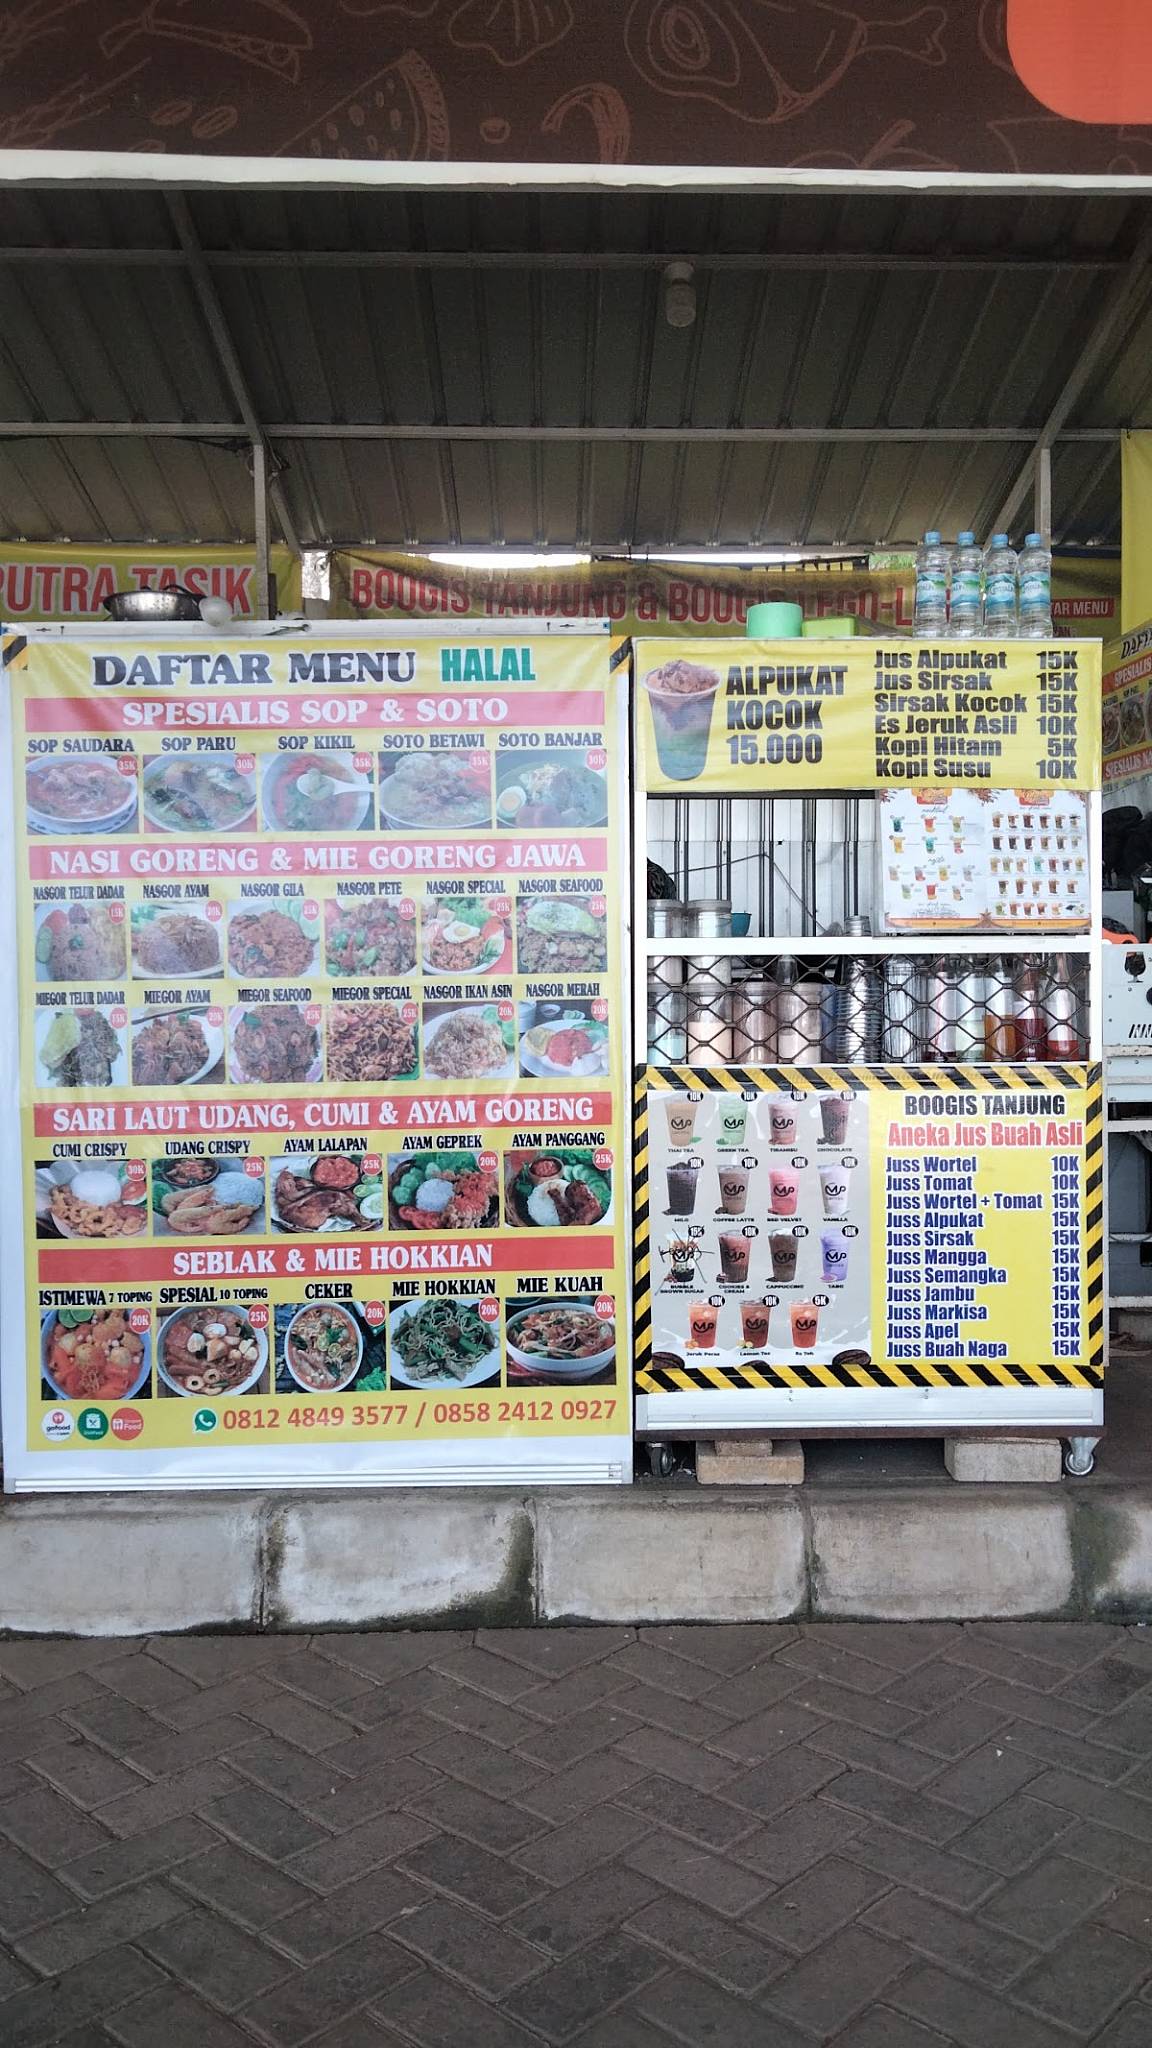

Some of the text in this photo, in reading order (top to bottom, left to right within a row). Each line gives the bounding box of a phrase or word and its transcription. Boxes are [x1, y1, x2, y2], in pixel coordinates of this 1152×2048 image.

[0, 566, 117, 613] UTRA
[353, 568, 657, 620] BOOGIS TANJUNG &
[1073, 601, 1108, 615] MENU
[93, 648, 536, 686] DAFTAR MENU HALAL
[874, 650, 1078, 669] Jus Alpukat 15K
[726, 666, 848, 695] ALPUKAT
[874, 671, 1078, 691] Jus Sirsak 15K
[874, 693, 1078, 713] Sirsak Kocok 15K
[123, 698, 508, 725] SPESIALIS SOP & SOTO
[726, 700, 823, 730] KOCOK
[875, 715, 1078, 735] Es Jeruk Asli 10K
[28, 738, 134, 753] SOP SAUDARA
[161, 737, 236, 751] SOP PARU
[278, 735, 355, 749] SOP KIKIL
[383, 734, 485, 749] SOTO BETAWI
[499, 732, 603, 747] SOTO BANJAR
[875, 737, 1077, 757] Kopi Hitam 5K
[726, 734, 823, 764] 15.000
[118, 759, 136, 771] 35K
[875, 758, 1077, 779] Kopi Susu 10K
[50, 844, 585, 874] NASI GORENG & MIE GORENG JAWA
[143, 884, 209, 898] NASGOR AYAM
[426, 880, 506, 894] NASGOR SPECIAL
[332, 987, 412, 1001] MIEGOR SPECIAL
[424, 984, 512, 999] NASGOR IKAN ASIN
[526, 983, 600, 997] NASGOR MERAH
[905, 1095, 1065, 1116] BOOGIS TANJUNG
[53, 1099, 593, 1132] SARI LAUT UDANG, CUMI & AYAM GORENG
[512, 1132, 605, 1147] AYAM PANGGANG
[888, 1121, 1083, 1147] Aneka Jus Buah Asli
[53, 1143, 127, 1157] CUMI CRISPY
[165, 1141, 251, 1155] UDANG CRISPY
[284, 1138, 367, 1152] AYAM LALAPAN
[402, 1136, 482, 1149] AYAM GEPREK
[363, 1160, 380, 1169] 25K
[595, 1155, 612, 1164] 25K
[744, 1158, 755, 1167] 10K
[886, 1156, 1080, 1172] Juss Wortel 10K
[886, 1174, 1080, 1191] Juss Tomat 10K
[886, 1193, 1080, 1210] Juss Wortel + Tomat 15K
[886, 1212, 1080, 1229] Juss Alpukat 15K
[744, 1227, 755, 1237] 10K
[173, 1244, 493, 1275] SEBLAK & MIE HOKKIAN
[886, 1267, 1080, 1285] Juss Semangka 15K
[305, 1284, 352, 1299] CEKER
[392, 1279, 496, 1296] MIE HOKKIAN
[517, 1277, 603, 1293] MIE KUAH
[39, 1290, 152, 1306] ISTIMEWA 7 TOPING
[159, 1287, 268, 1303] SPESIAL 10 TOPING
[765, 1297, 776, 1306] 10K
[816, 1296, 826, 1305] 5K
[366, 1308, 384, 1318] 20K
[481, 1305, 498, 1315] 20K
[597, 1302, 613, 1312] 20K
[250, 1312, 268, 1322] 25K
[886, 1322, 1080, 1340] Juss Apel 15K
[886, 1340, 1080, 1359] Juss Buah Naga 15K
[223, 1400, 617, 1430] 0812 4849 3577 / 0858 2412 0927
